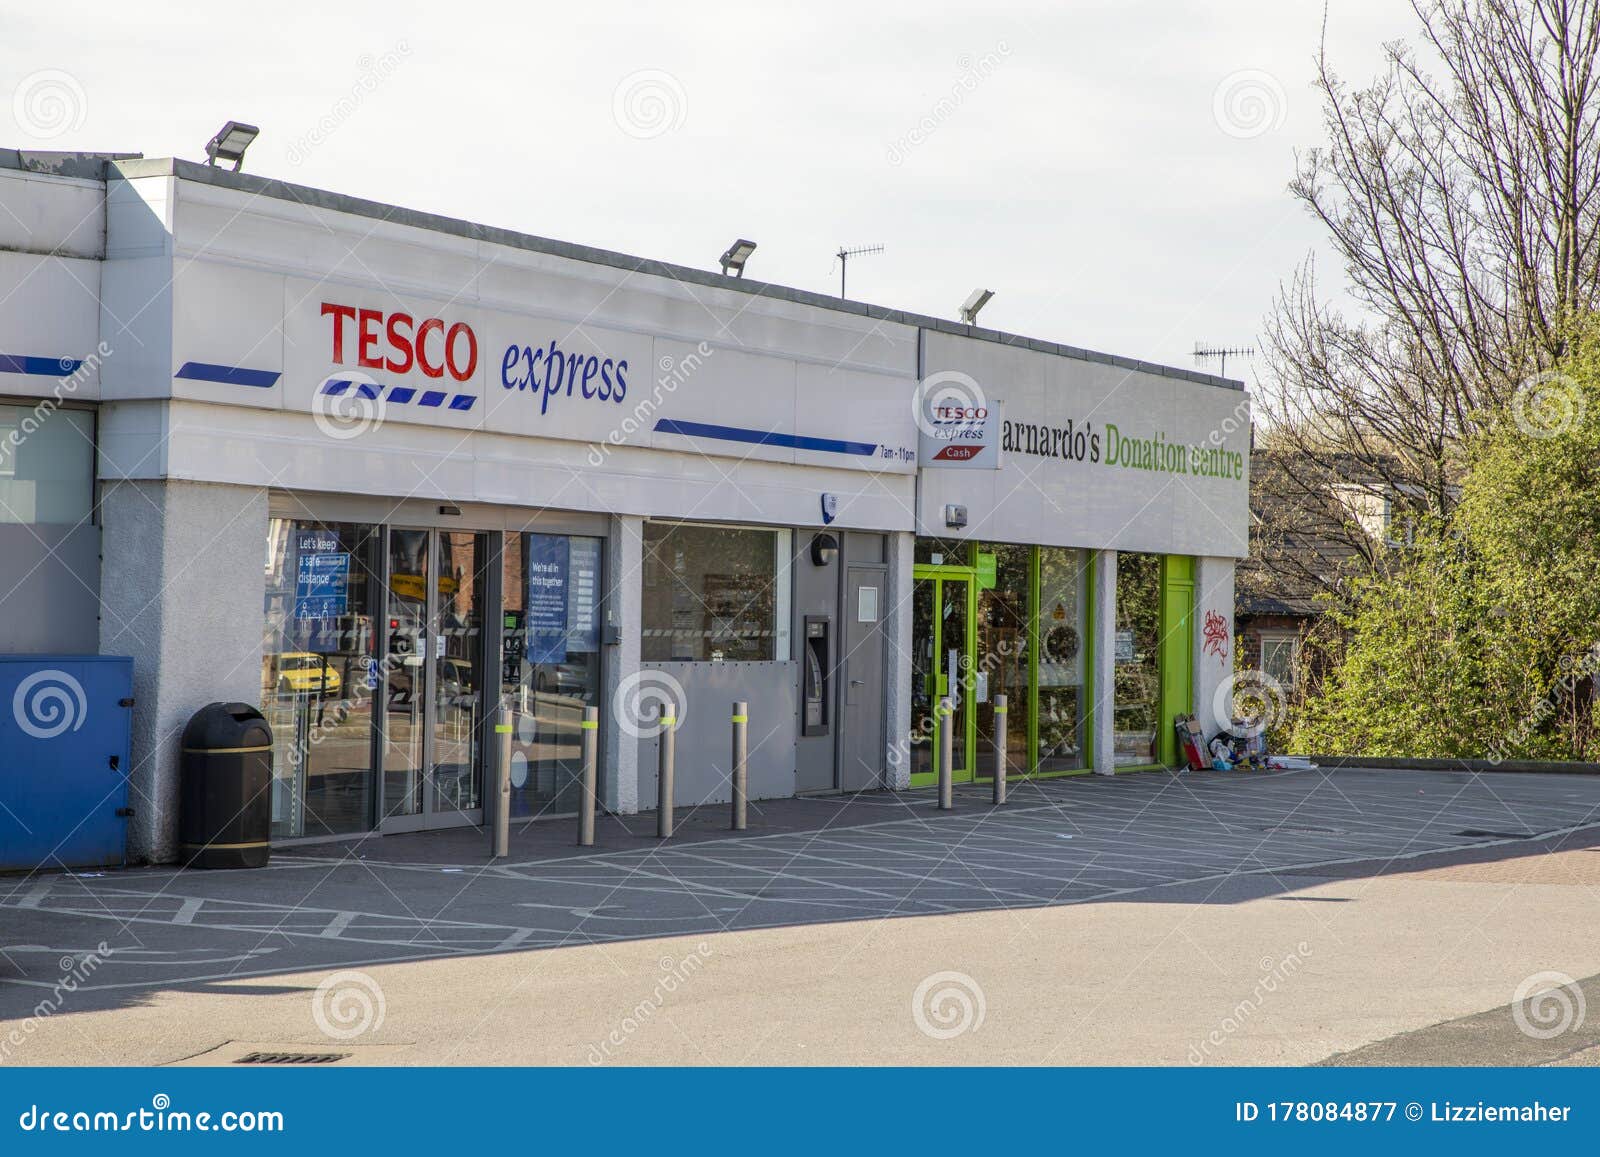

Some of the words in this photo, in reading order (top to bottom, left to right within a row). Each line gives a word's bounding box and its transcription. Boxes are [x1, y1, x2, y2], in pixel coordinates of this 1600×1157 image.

[321, 302, 478, 381] TESCO
[501, 340, 629, 415] express
[933, 406, 988, 419] TESCO
[934, 426, 984, 441] express
[881, 445, 894, 459] 7am
[899, 447, 915, 463] 11pm
[946, 447, 971, 458] Cash
[1002, 419, 1100, 463] arnardo's
[1104, 423, 1187, 474] Donation
[1191, 444, 1243, 480] centre
[300, 536, 316, 549] Let's
[317, 537, 337, 552] keep
[305, 554, 320, 566] safe
[299, 572, 330, 584] distance
